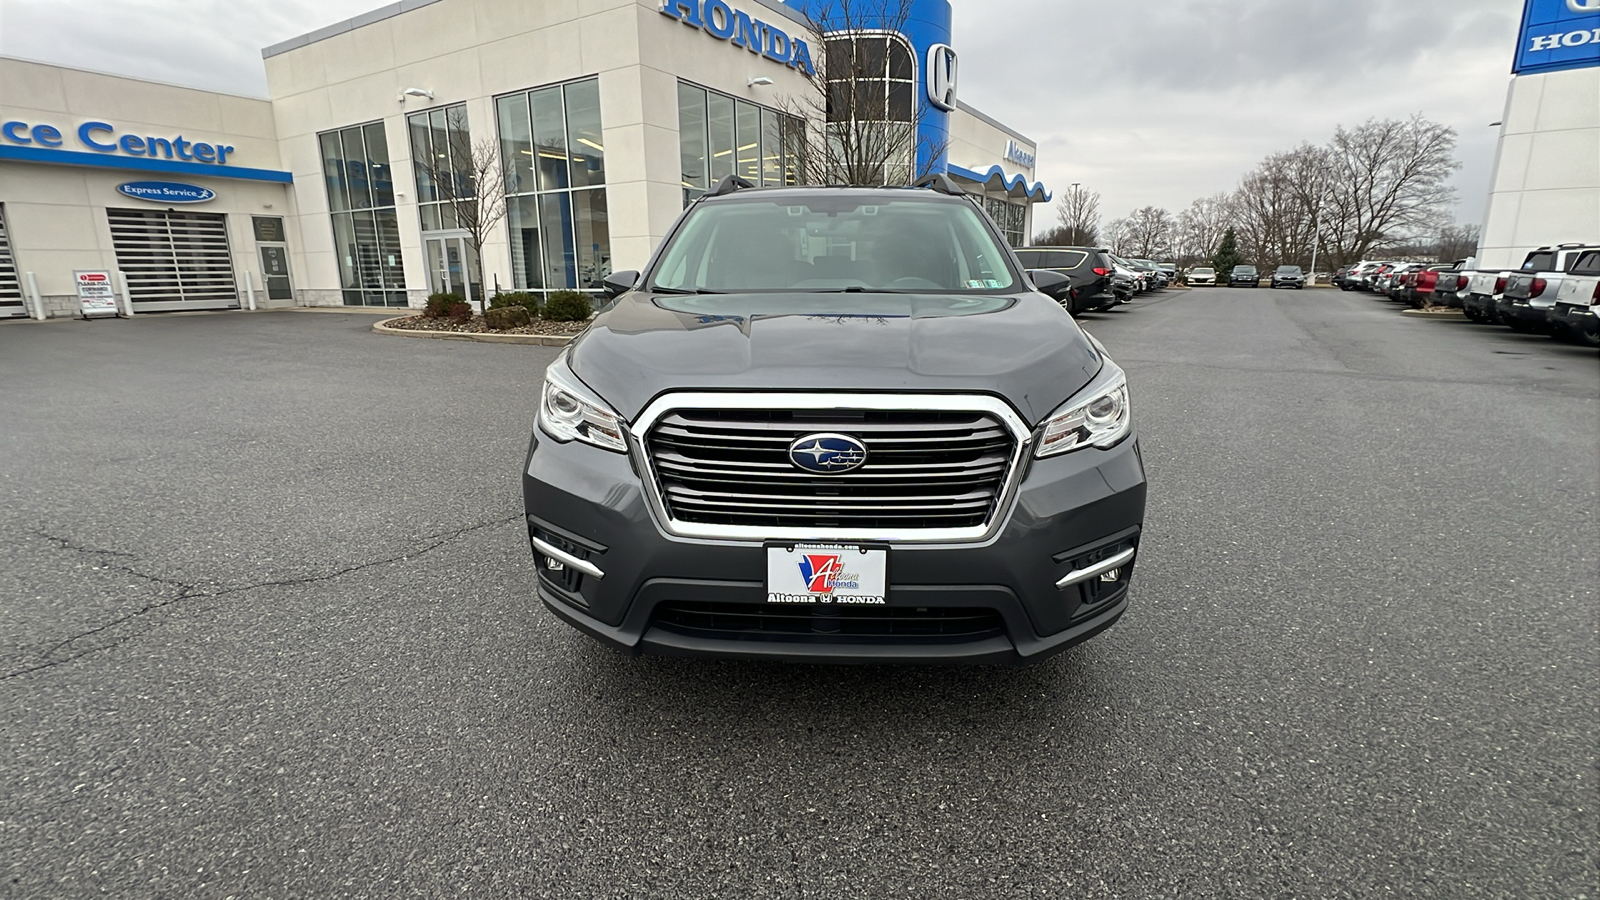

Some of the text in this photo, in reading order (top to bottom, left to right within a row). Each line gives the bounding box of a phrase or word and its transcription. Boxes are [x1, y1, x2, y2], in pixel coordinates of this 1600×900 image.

[660, 0, 816, 76] HONDA
[78, 121, 234, 164] Center
[124, 185, 198, 197] Express Service
[828, 580, 858, 589] Honda
[767, 593, 816, 603] Altoona
[837, 595, 885, 604] HONDA
